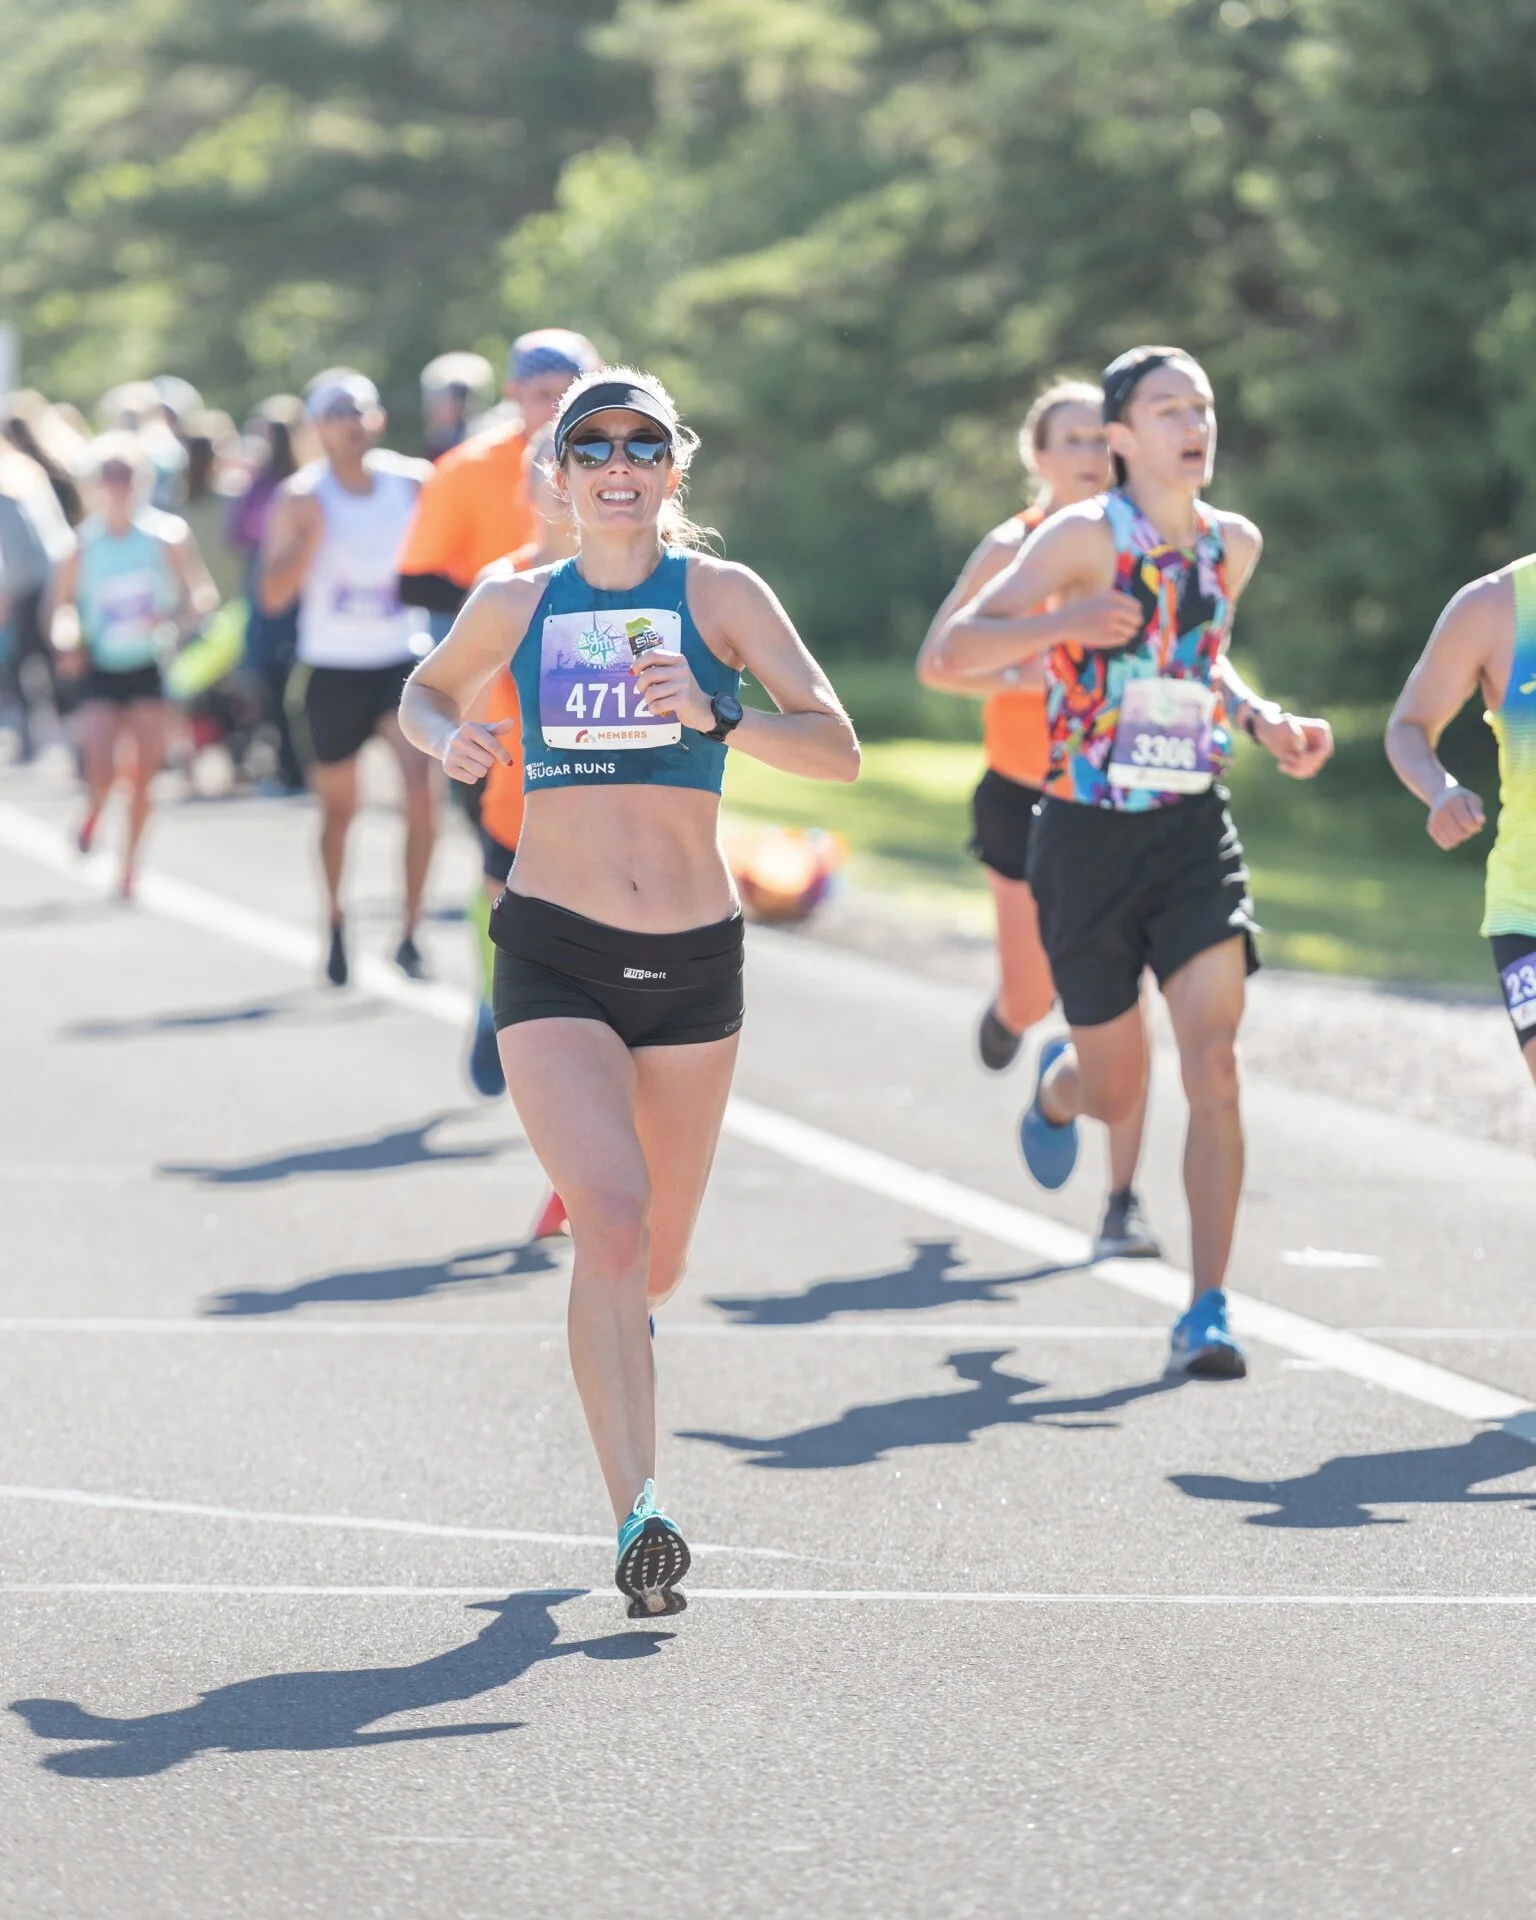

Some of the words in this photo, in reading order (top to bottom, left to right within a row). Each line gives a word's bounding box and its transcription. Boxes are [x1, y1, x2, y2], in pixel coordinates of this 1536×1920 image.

[598, 730, 648, 740] MEMBERS
[532, 763, 571, 780] SUGAR
[574, 762, 616, 774] RUNS
[623, 968, 667, 980] FlipBelt
